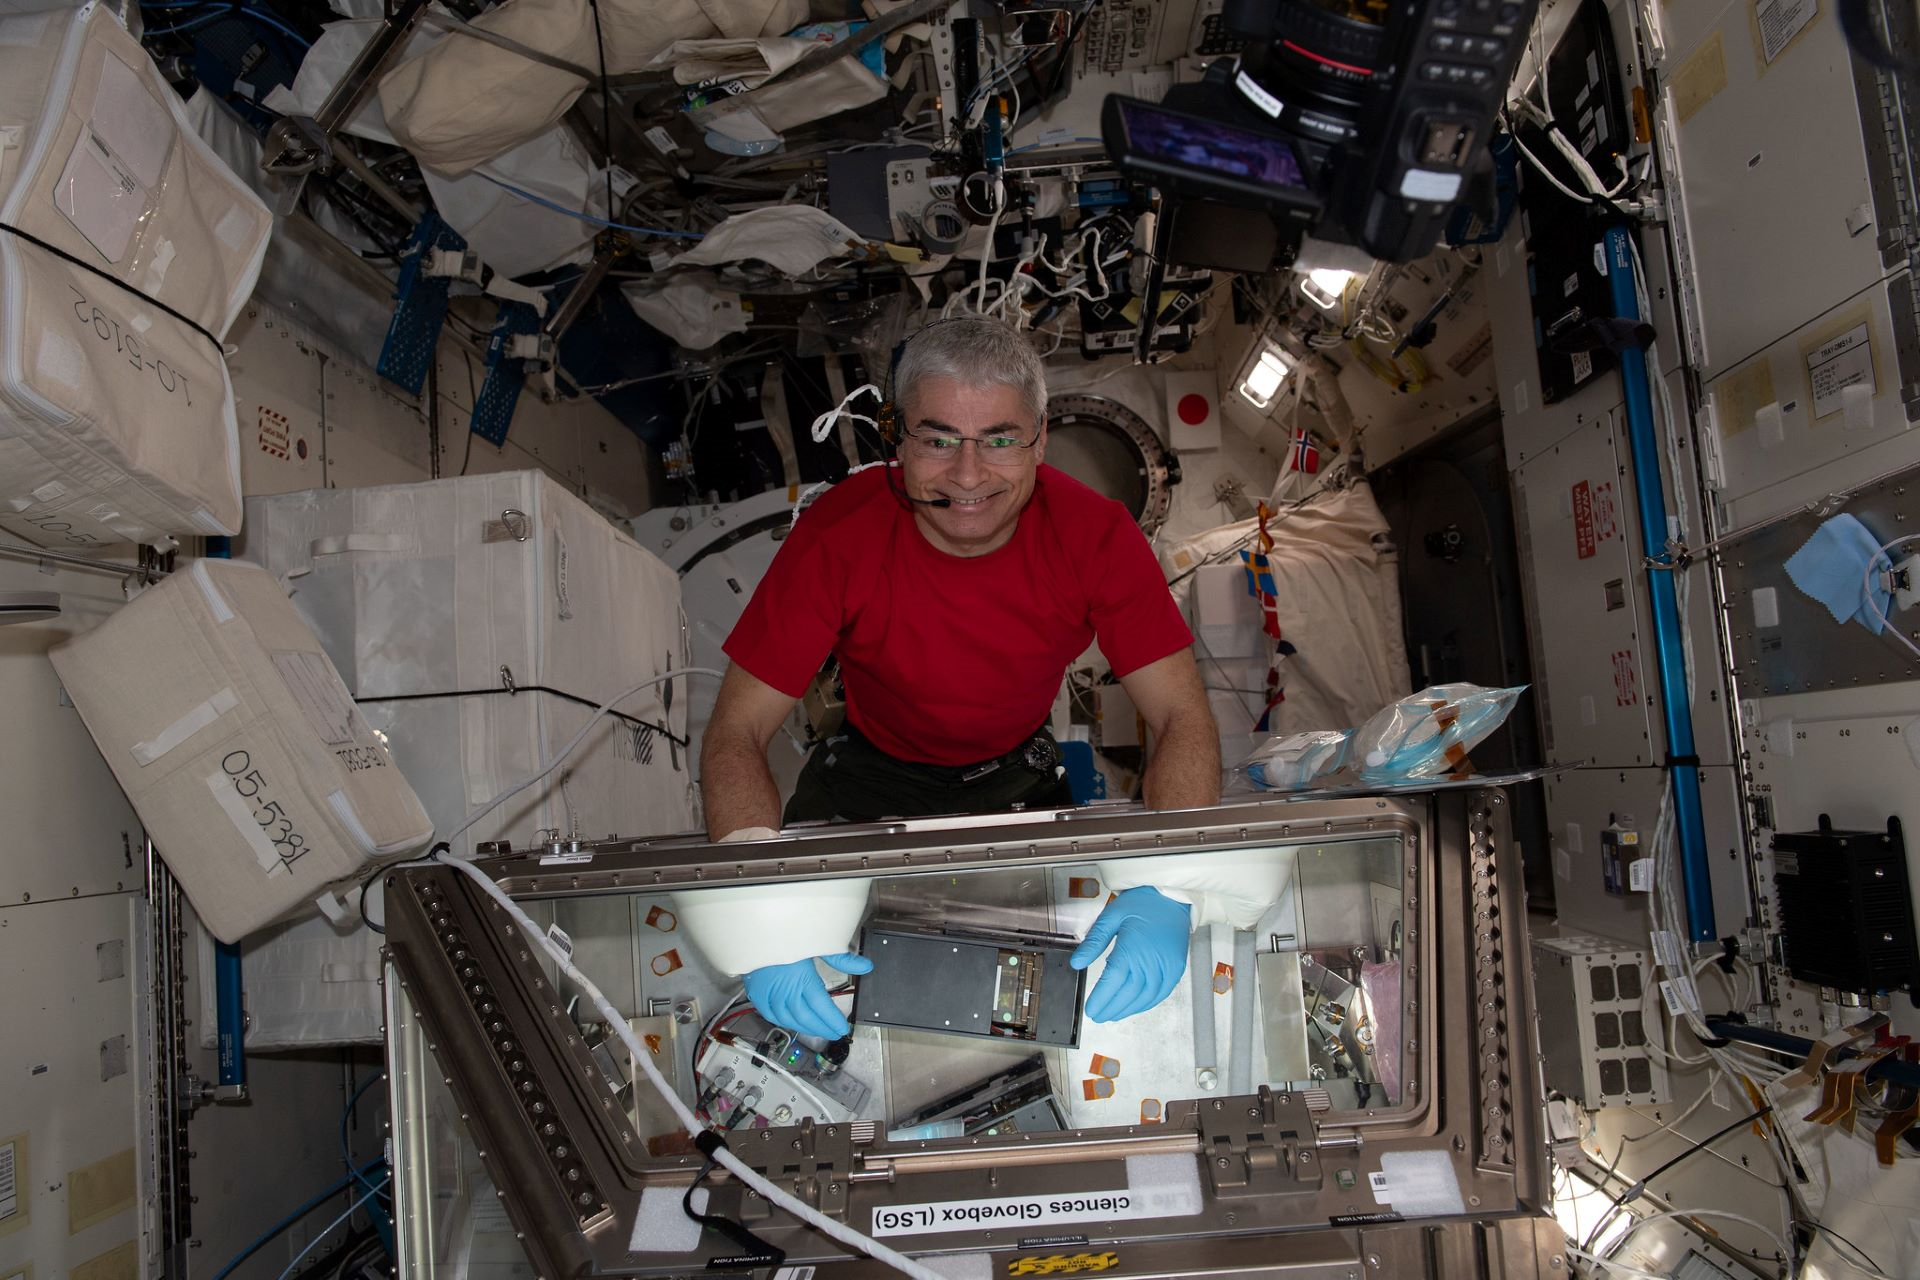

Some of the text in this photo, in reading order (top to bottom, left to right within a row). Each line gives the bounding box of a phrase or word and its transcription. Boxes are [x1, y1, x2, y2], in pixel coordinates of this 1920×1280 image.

[1574, 486, 1584, 521] MIST
[1583, 491, 1593, 548] WATER
[875, 1207, 935, 1229] (LSG)
[942, 1202, 1043, 1223] Glovebox
[1337, 1213, 1396, 1222] ILLUMINATION
[1023, 1236, 1083, 1244] ILLUMINATION
[713, 1256, 771, 1264] ILLUMINATION
